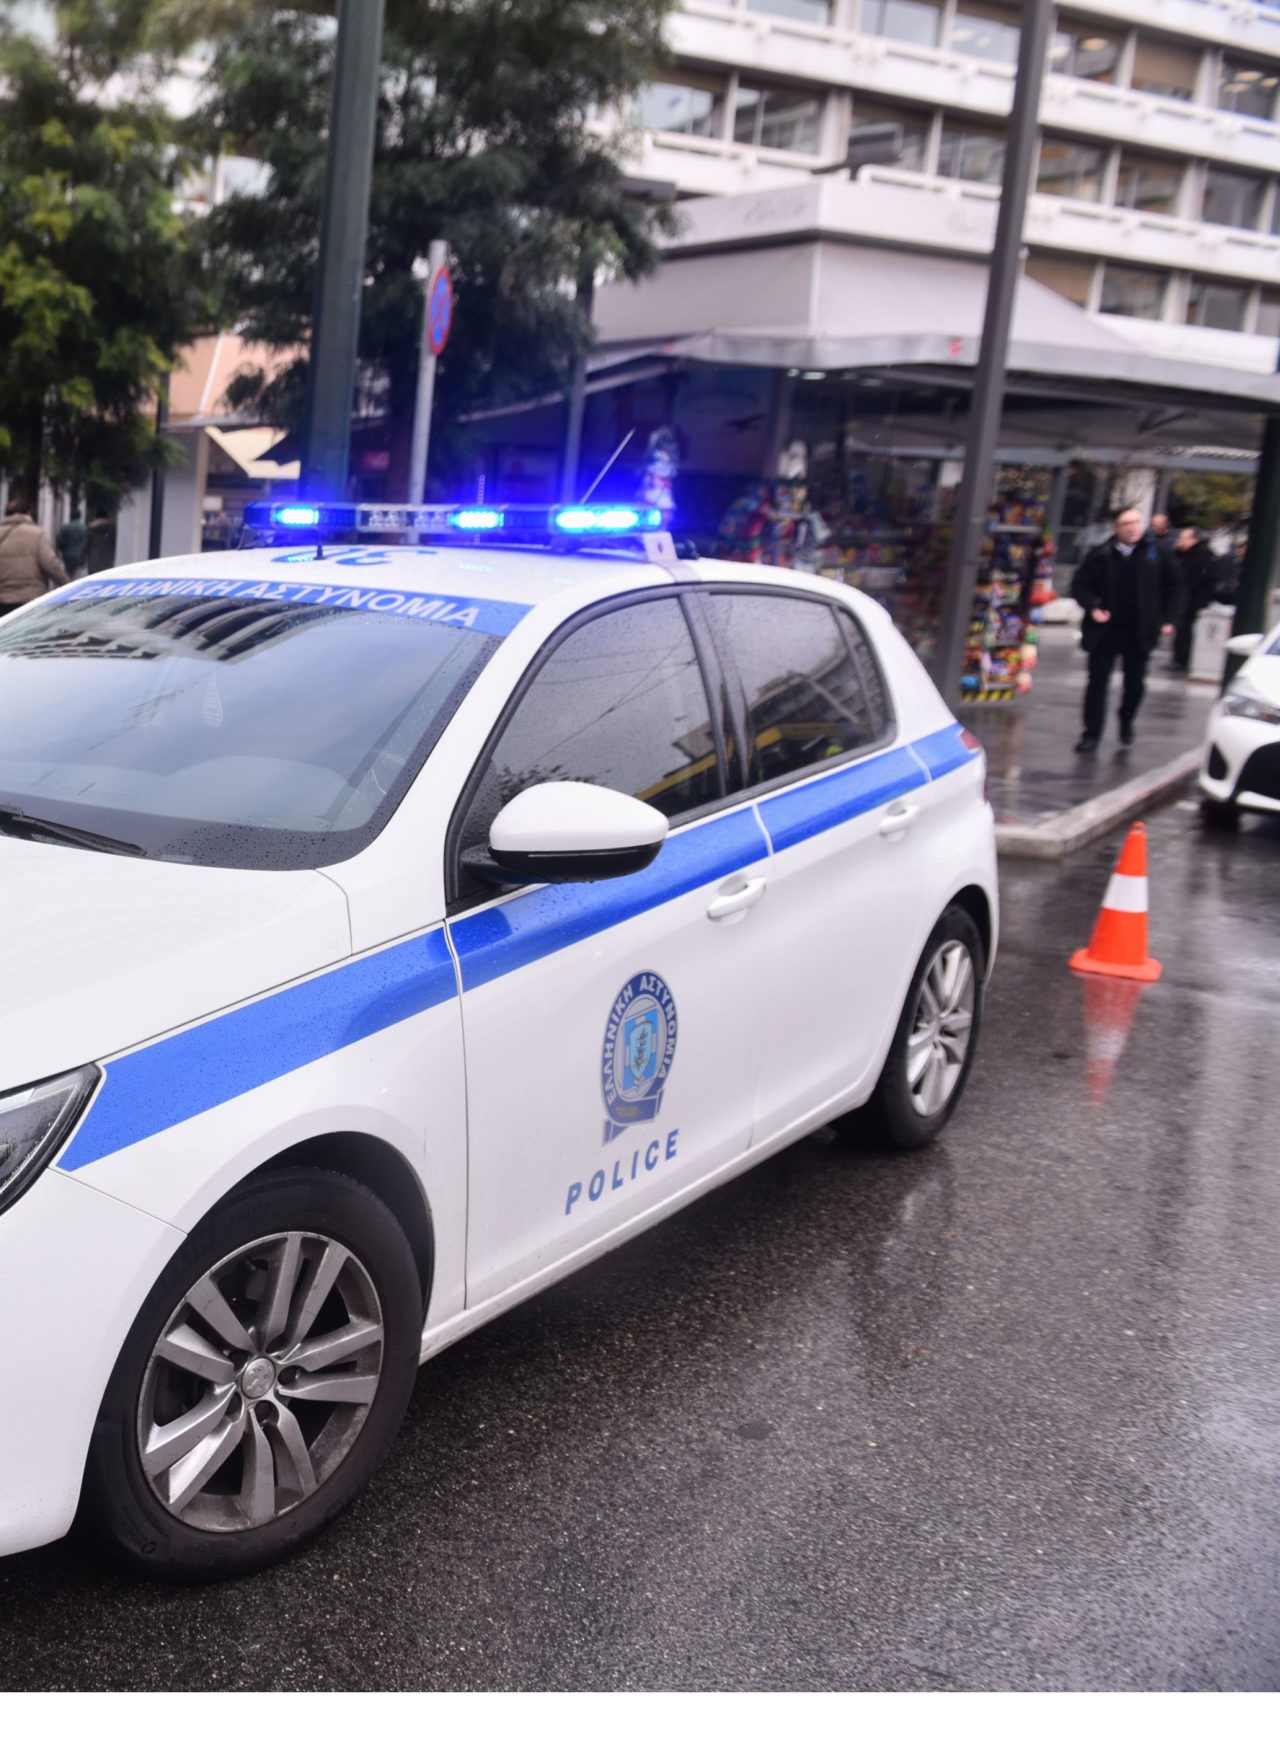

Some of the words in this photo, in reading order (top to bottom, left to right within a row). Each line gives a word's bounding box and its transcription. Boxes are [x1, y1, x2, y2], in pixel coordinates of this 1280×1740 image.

[241, 580, 481, 628] ΑΣΤΥΝΟΜΙΑ
[639, 974, 678, 1080] ΑΣΤΥΝΟΜΙΑ
[565, 1128, 680, 1215] POLICE
